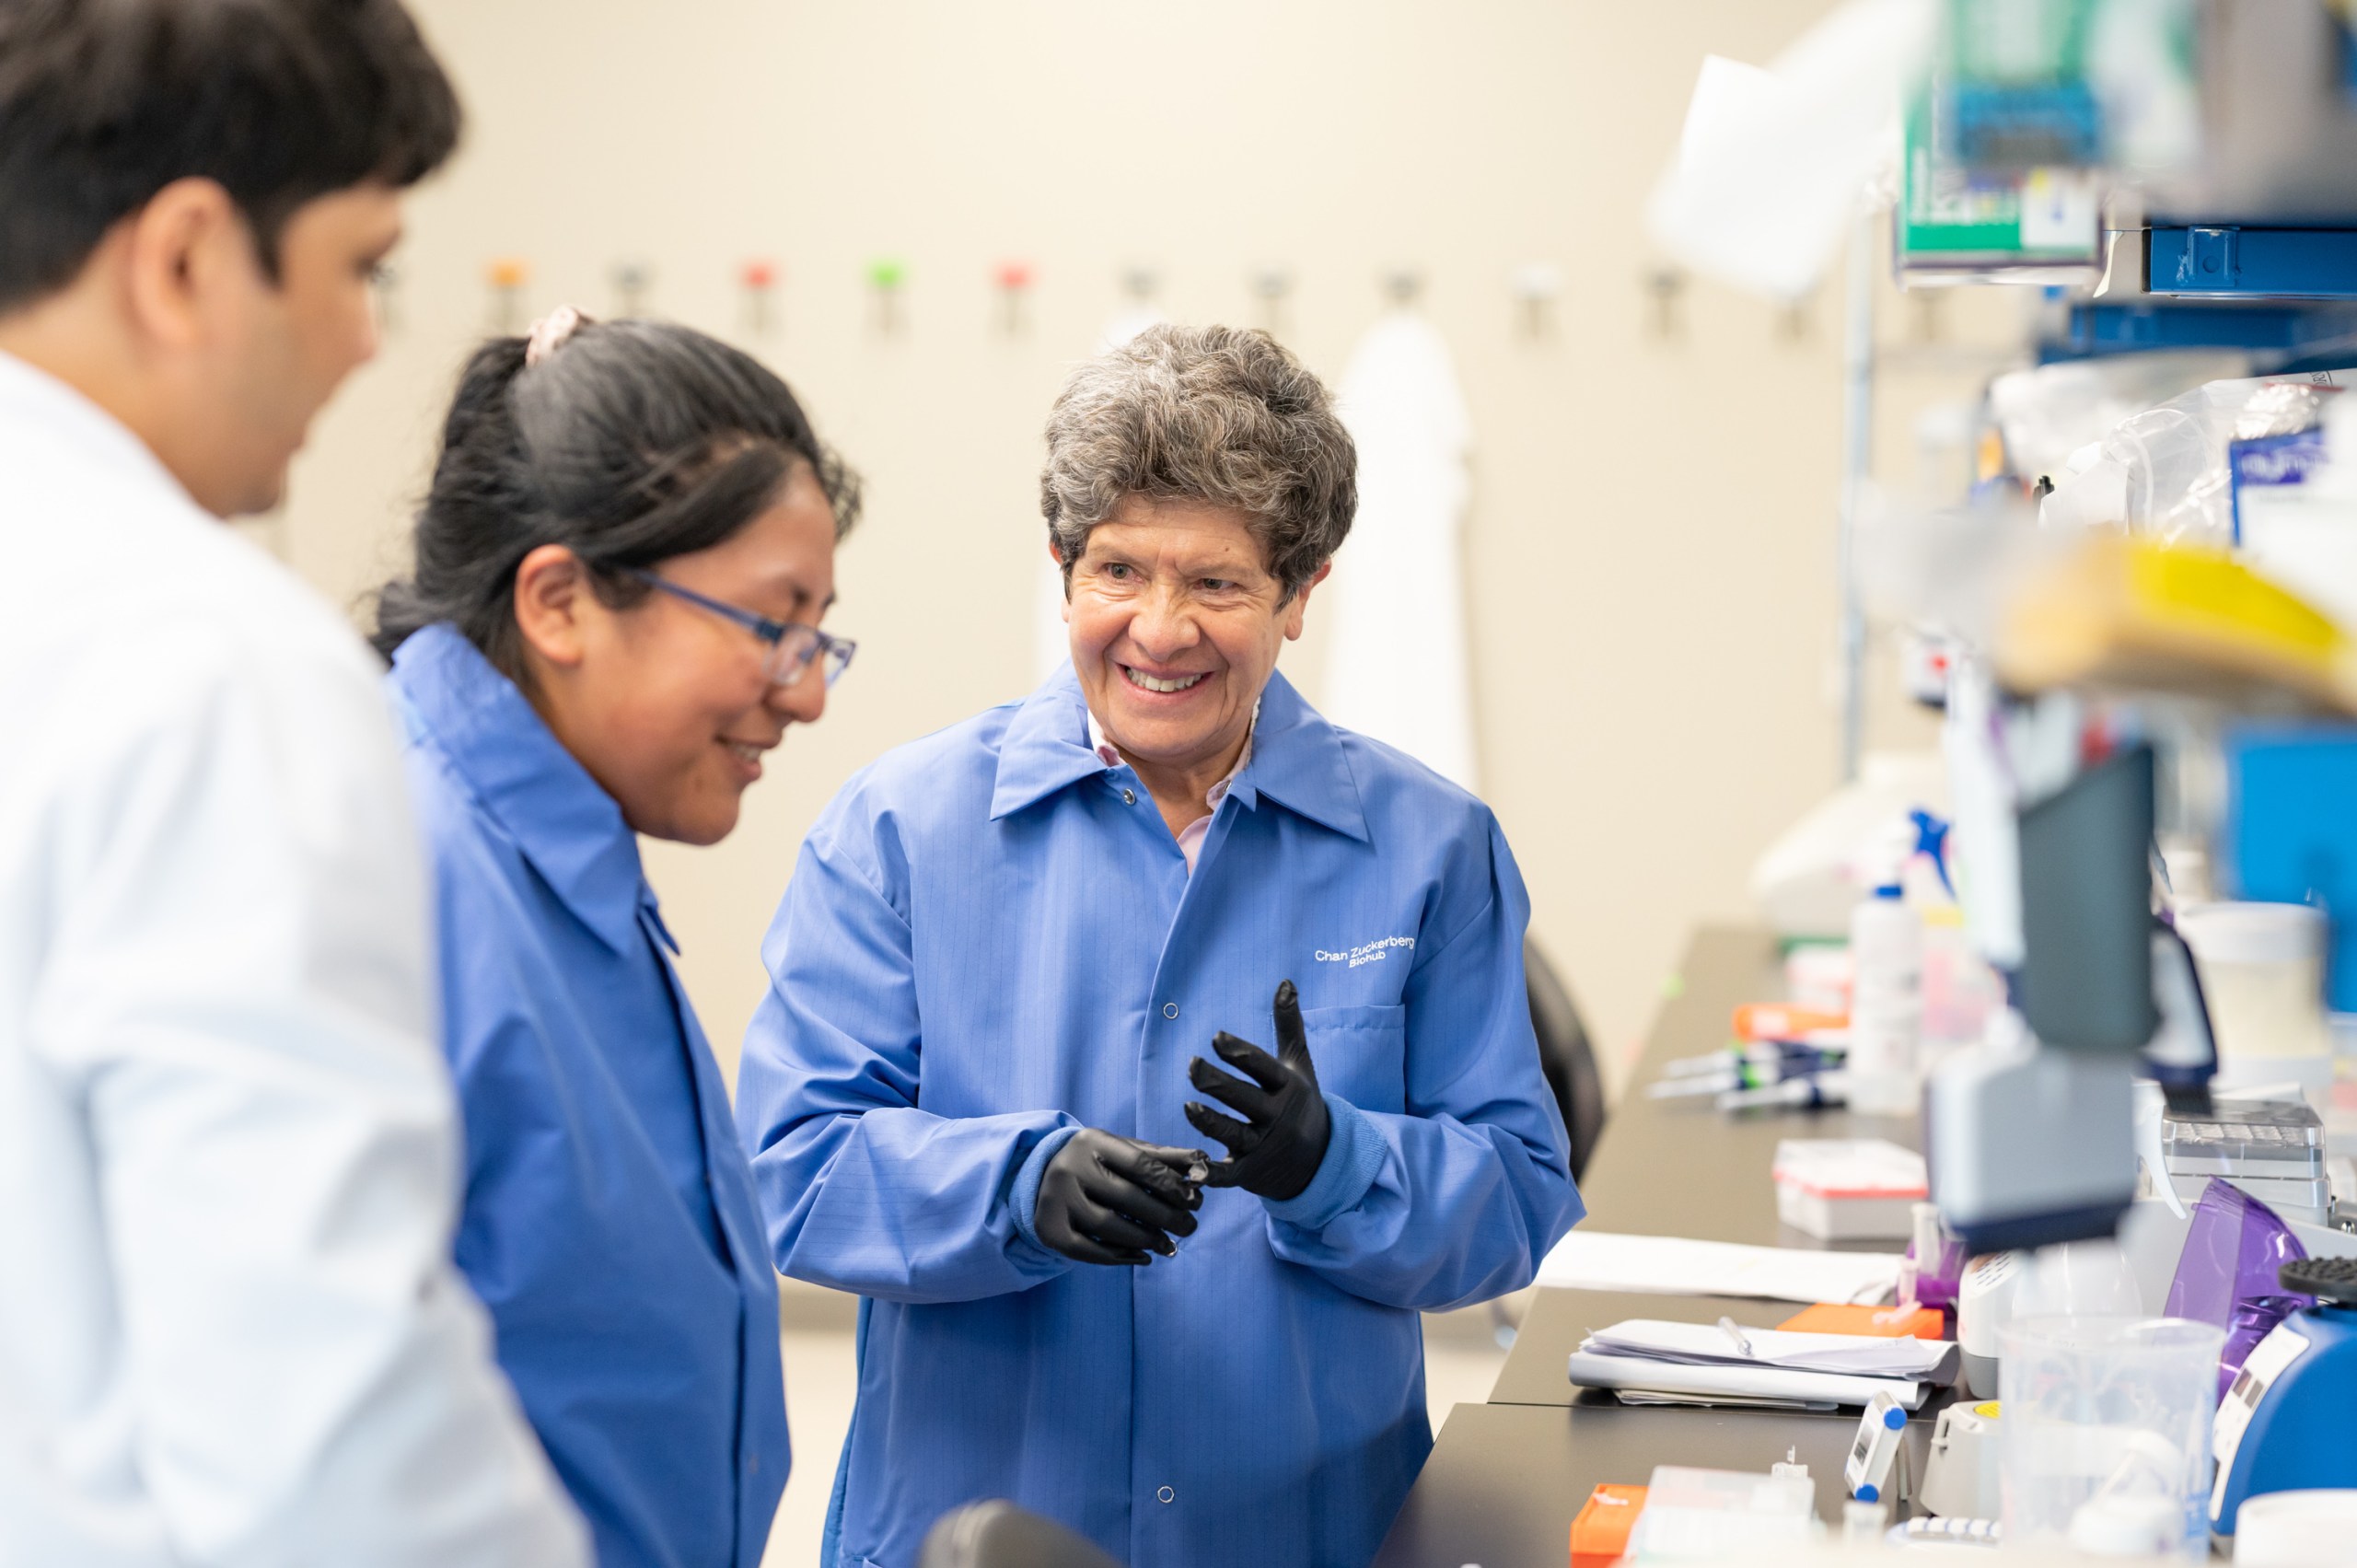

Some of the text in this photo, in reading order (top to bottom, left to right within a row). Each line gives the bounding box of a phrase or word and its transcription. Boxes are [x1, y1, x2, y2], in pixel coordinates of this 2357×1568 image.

[1315, 935, 1415, 961] Chan Zuckerberg
[1349, 950, 1386, 968] Biohub
